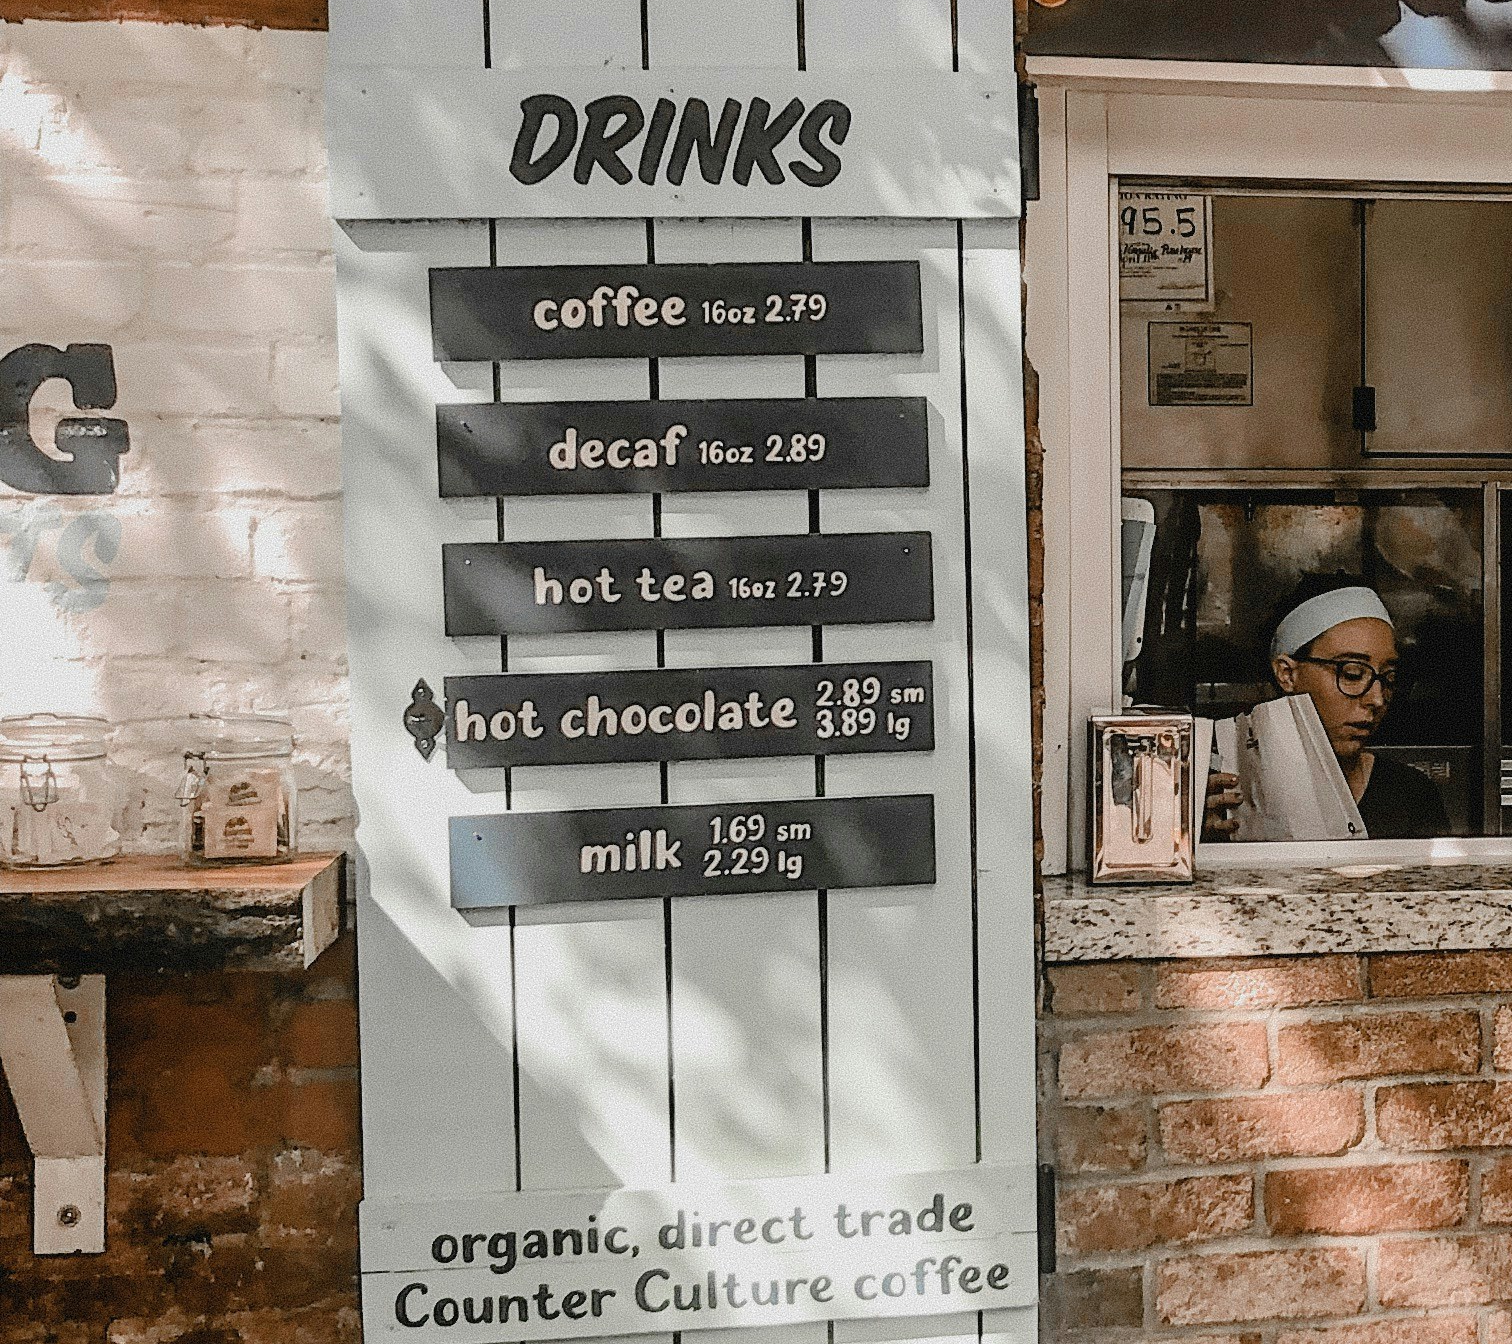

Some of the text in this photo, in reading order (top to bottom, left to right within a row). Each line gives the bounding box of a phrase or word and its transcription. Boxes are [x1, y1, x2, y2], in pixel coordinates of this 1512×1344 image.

[509, 94, 851, 188] DRINKS
[1121, 206, 1195, 237] 95.5
[533, 286, 827, 331] coffee 16oz 2.79
[549, 425, 826, 470] decaf 16oz 2.89
[533, 567, 848, 606] hot tea 16oz 2.79
[816, 677, 925, 706] 2.89 sm
[455, 692, 799, 743] hot chocolate
[816, 709, 910, 741] 3.89 lg
[580, 829, 683, 873] milk
[709, 814, 812, 845] 1.69 sm
[704, 847, 803, 879] 2.29 lg
[430, 1193, 976, 1273] organic, direct trade
[394, 1255, 1011, 1329] Counter Culture coffee
